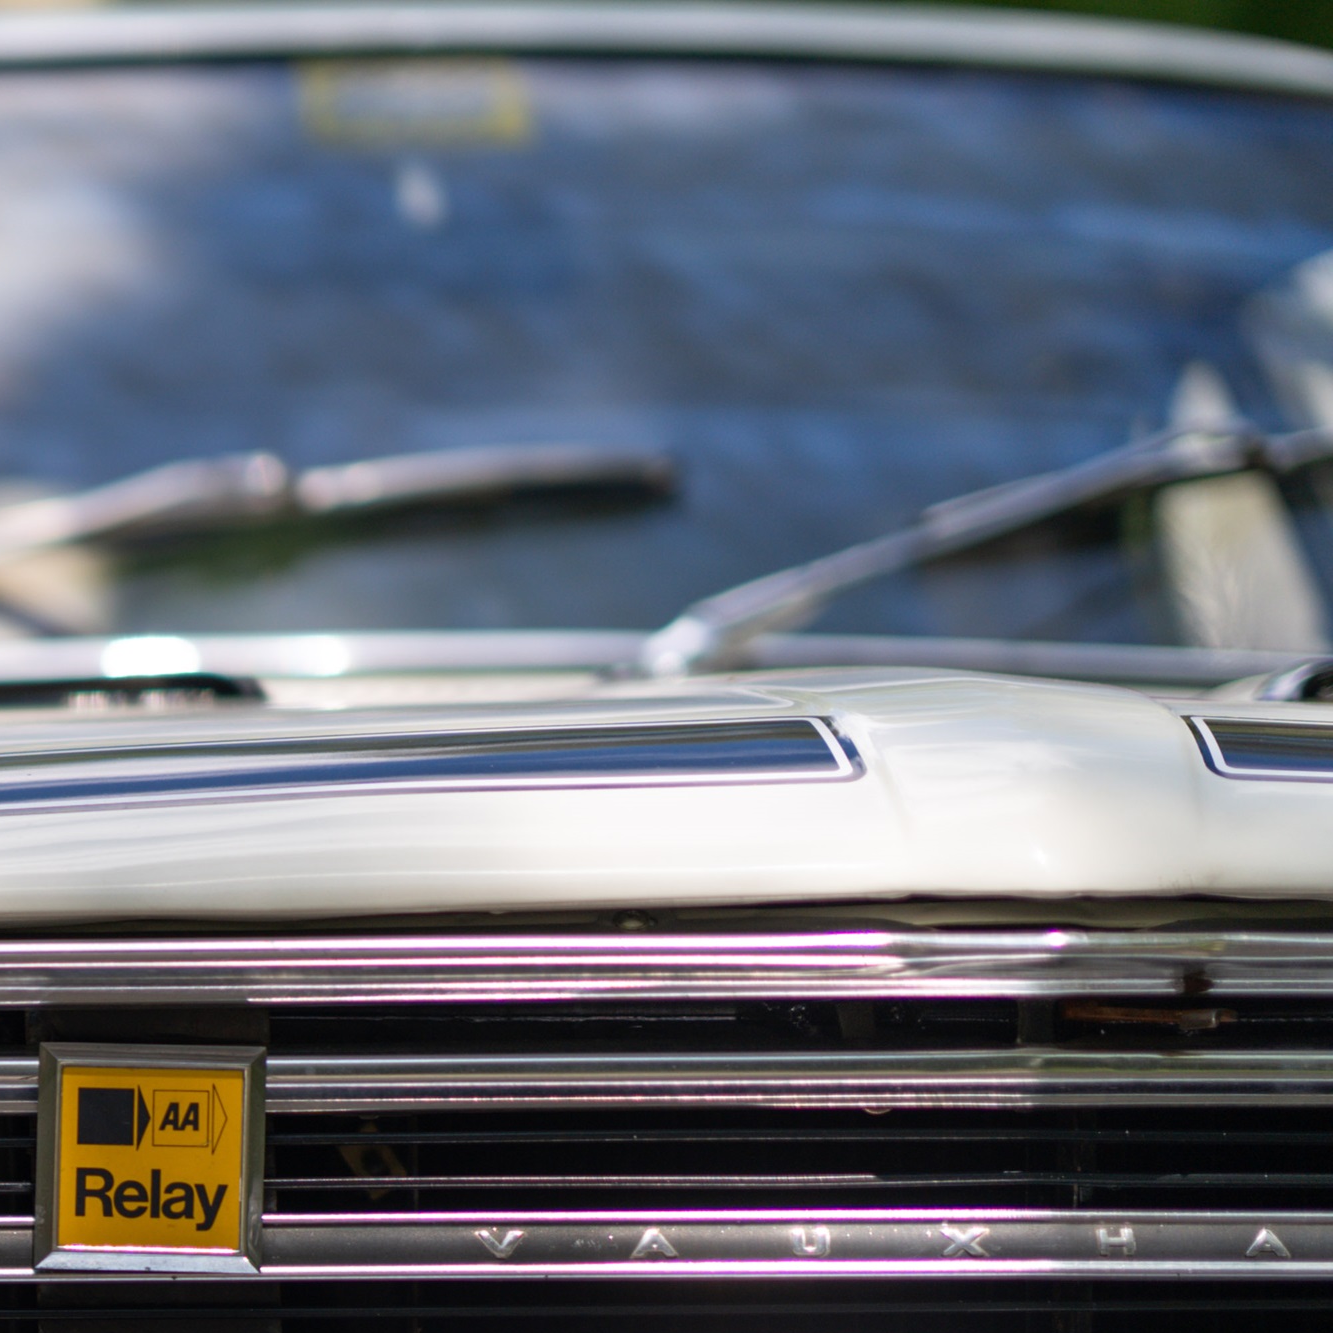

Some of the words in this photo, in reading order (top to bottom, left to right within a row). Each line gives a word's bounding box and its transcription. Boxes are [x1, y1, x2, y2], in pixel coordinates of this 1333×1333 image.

[158, 1102, 200, 1132] AA
[74, 1167, 229, 1232] Relay
[474, 1226, 1292, 1259] VAUXHA
